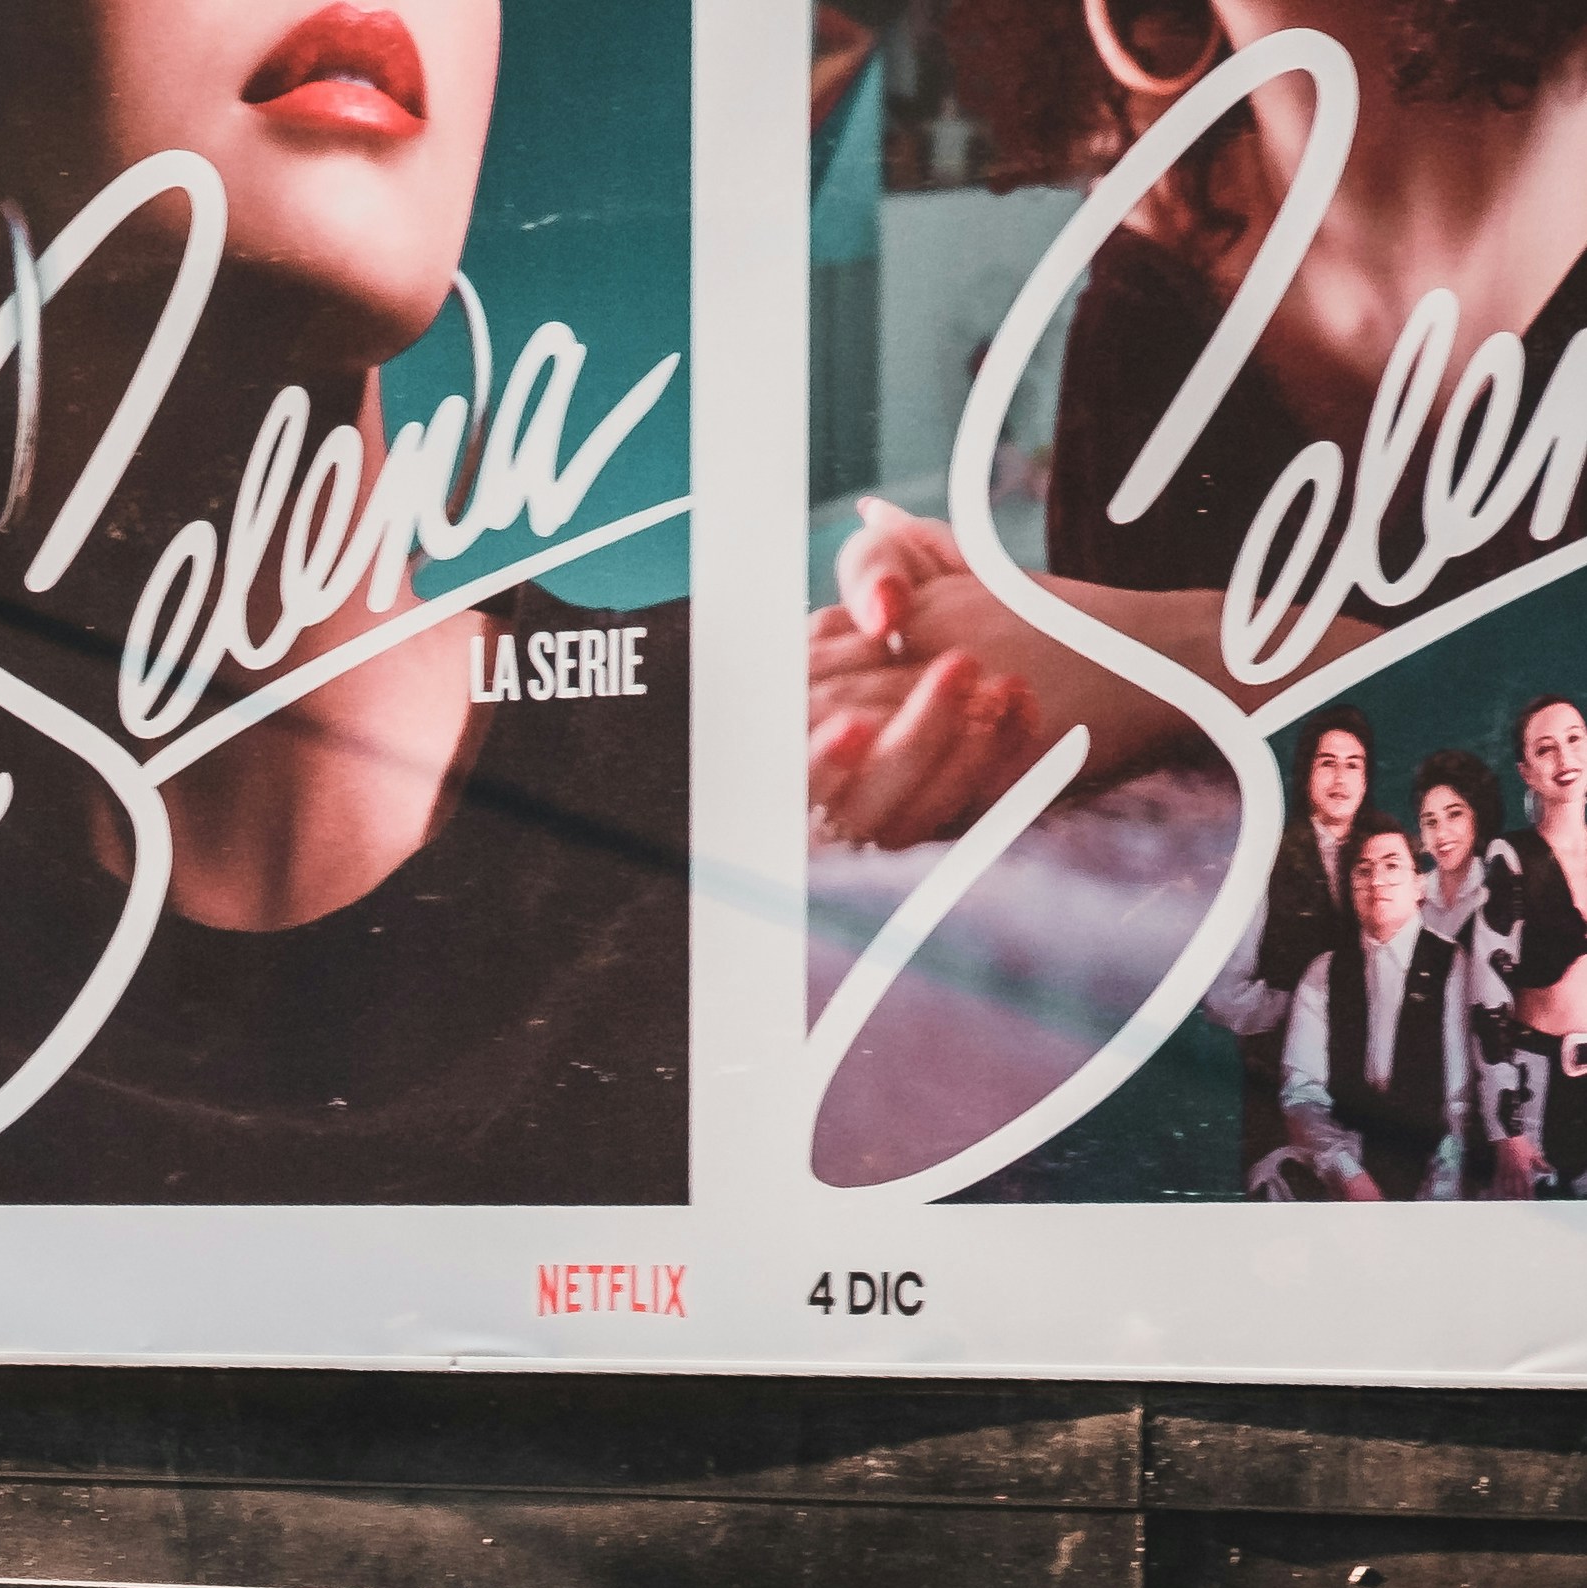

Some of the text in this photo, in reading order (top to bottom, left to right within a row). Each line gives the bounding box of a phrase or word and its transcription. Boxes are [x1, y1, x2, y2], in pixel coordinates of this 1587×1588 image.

[470, 627, 648, 703] LA SERIE
[537, 1264, 687, 1318] NETFLIX
[807, 1271, 926, 1317] 4 DIC
